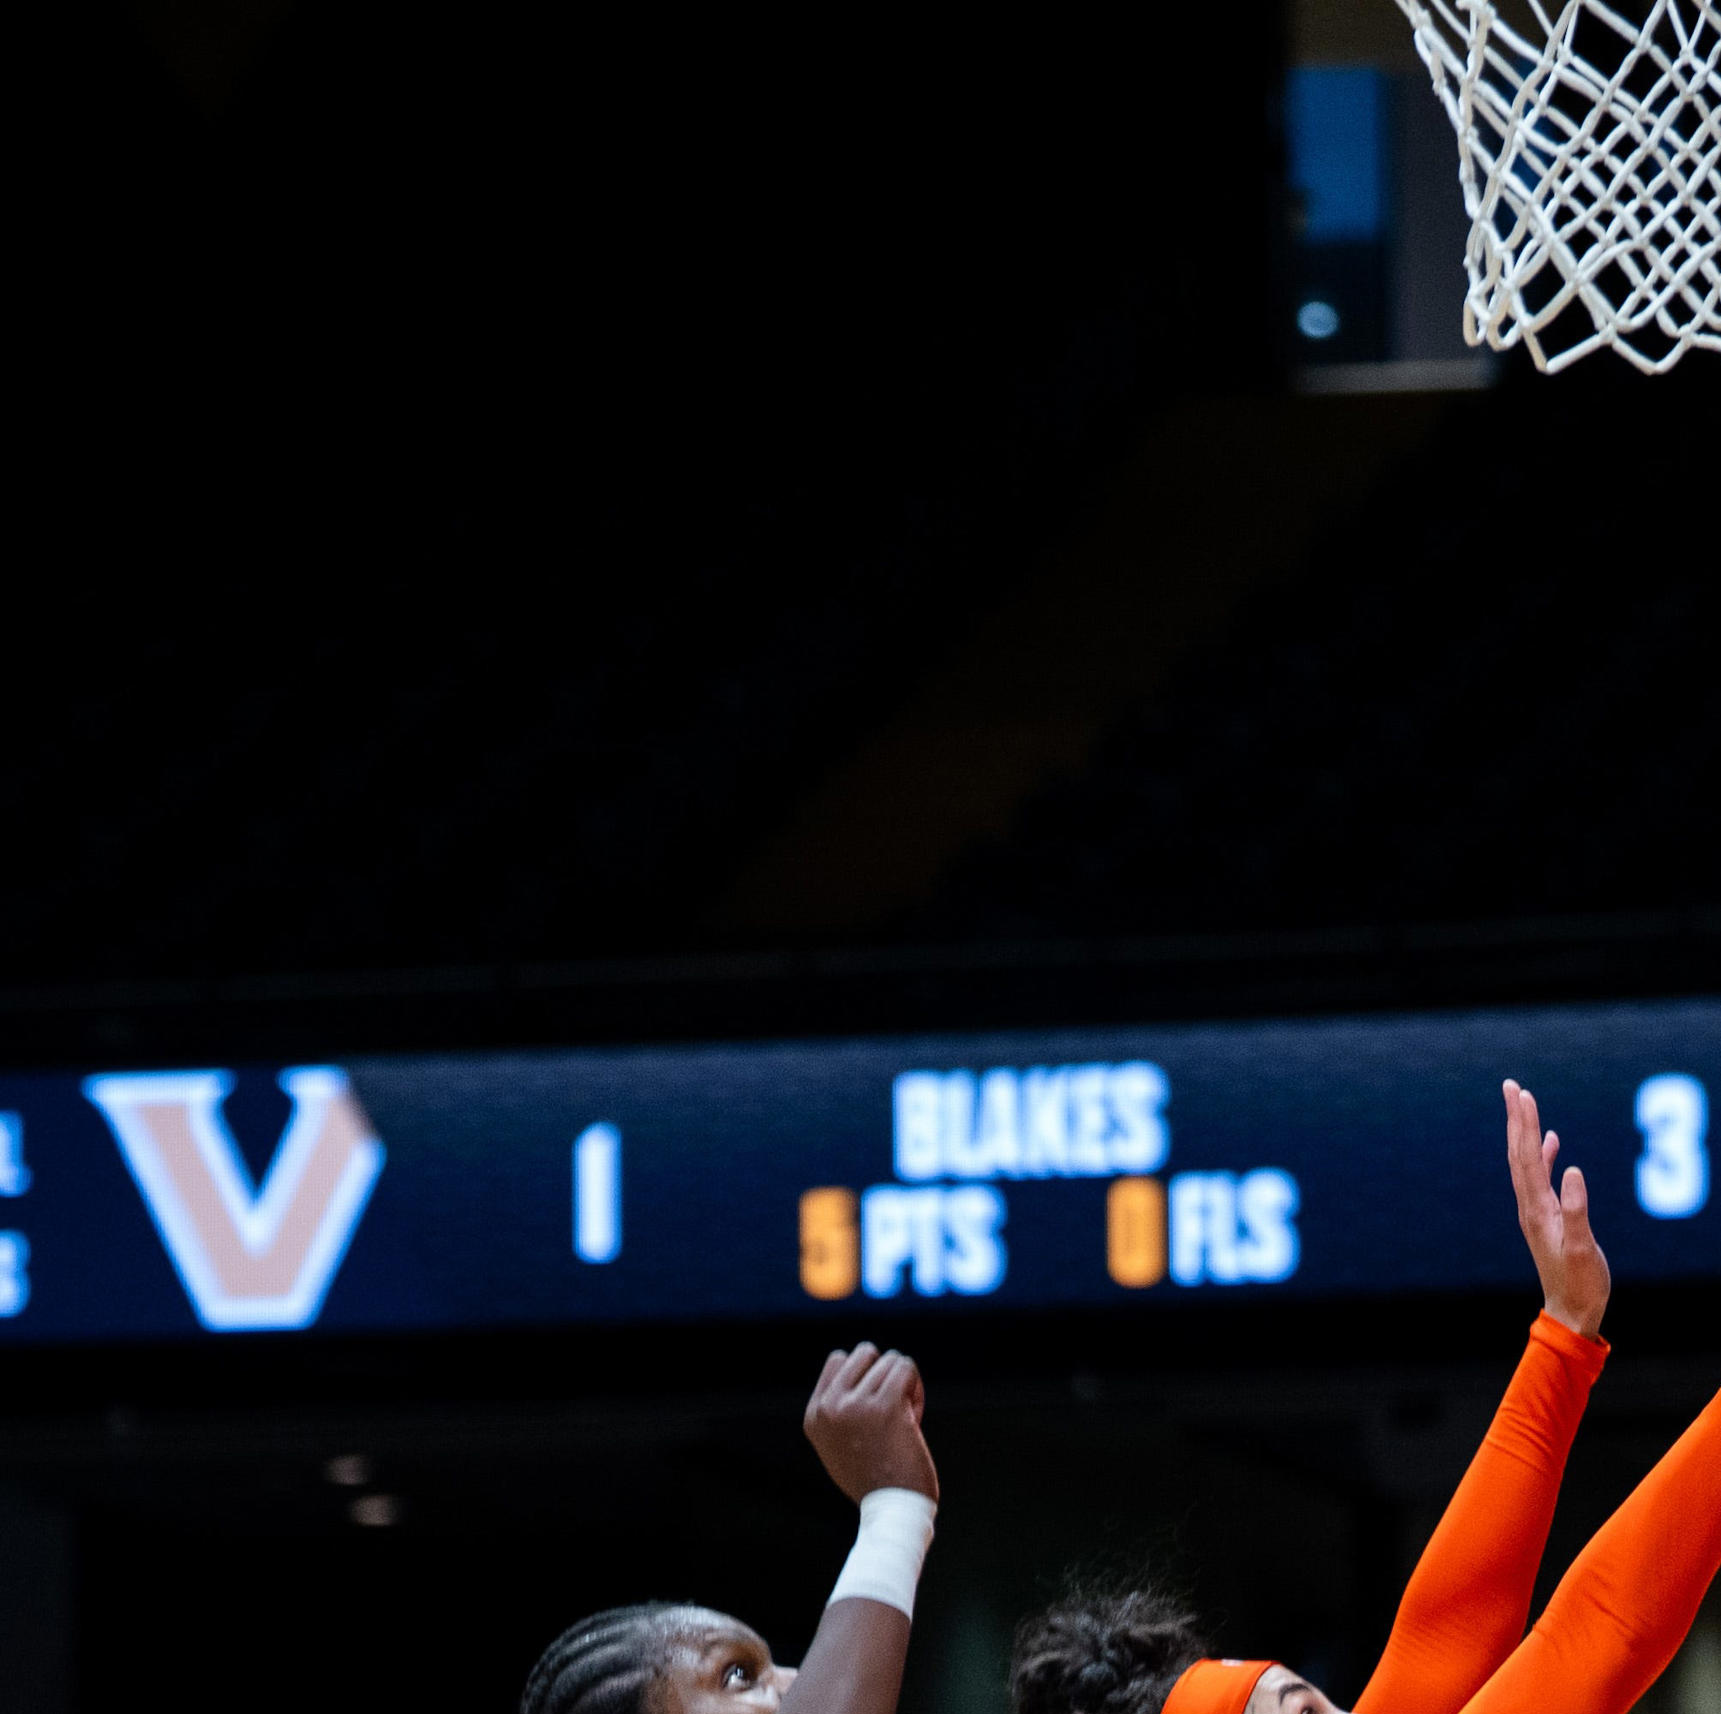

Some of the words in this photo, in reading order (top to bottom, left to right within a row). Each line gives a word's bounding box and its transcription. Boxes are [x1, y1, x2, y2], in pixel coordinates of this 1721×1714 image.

[572, 1122, 622, 1263] 1
[892, 1060, 1170, 1184] BLAKES
[1634, 1072, 1709, 1219] 3
[82, 1065, 386, 1332] V
[861, 1185, 1006, 1298] PTS
[1168, 1167, 1299, 1285] FLS
